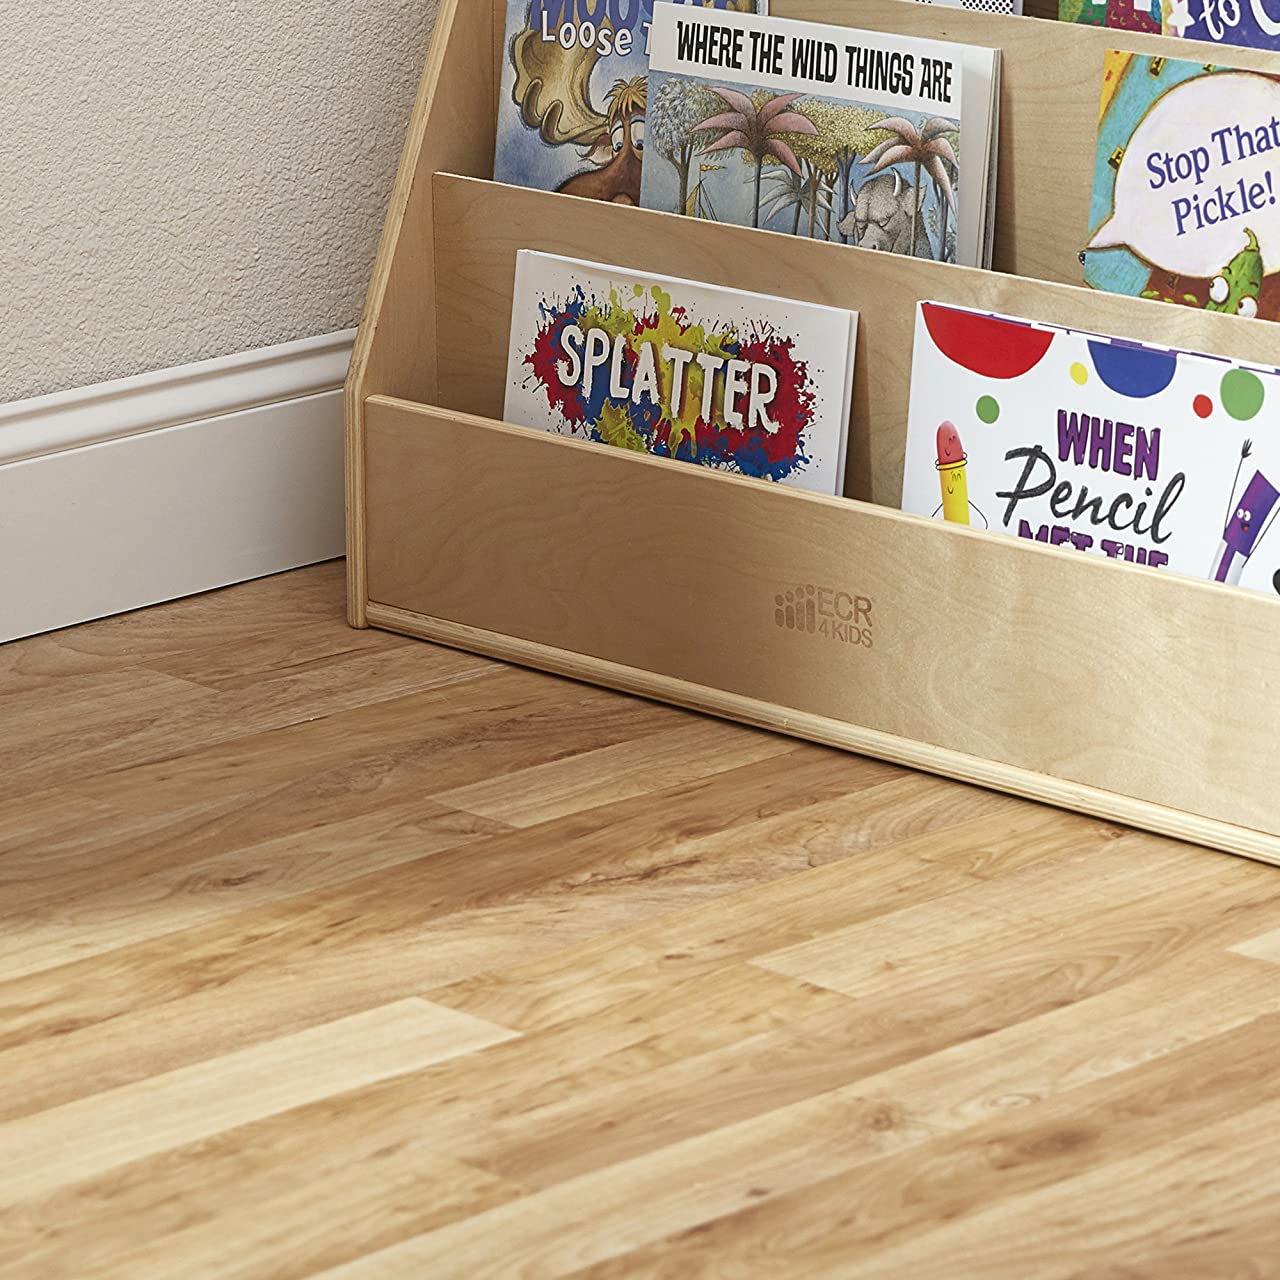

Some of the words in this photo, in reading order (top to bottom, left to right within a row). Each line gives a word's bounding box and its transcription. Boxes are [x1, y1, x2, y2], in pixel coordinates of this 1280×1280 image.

[676, 20, 743, 70] WHERE
[749, 30, 785, 75] THE
[790, 36, 839, 84] WILD
[845, 45, 915, 97] THINGS
[919, 58, 953, 104] ARE
[1146, 146, 1210, 190] Stop
[1171, 170, 1277, 236] Pickle!
[555, 324, 781, 435] SPLATTER
[1057, 409, 1161, 481] WHEN
[995, 444, 1186, 544] Pencil
[817, 586, 873, 628] ECR
